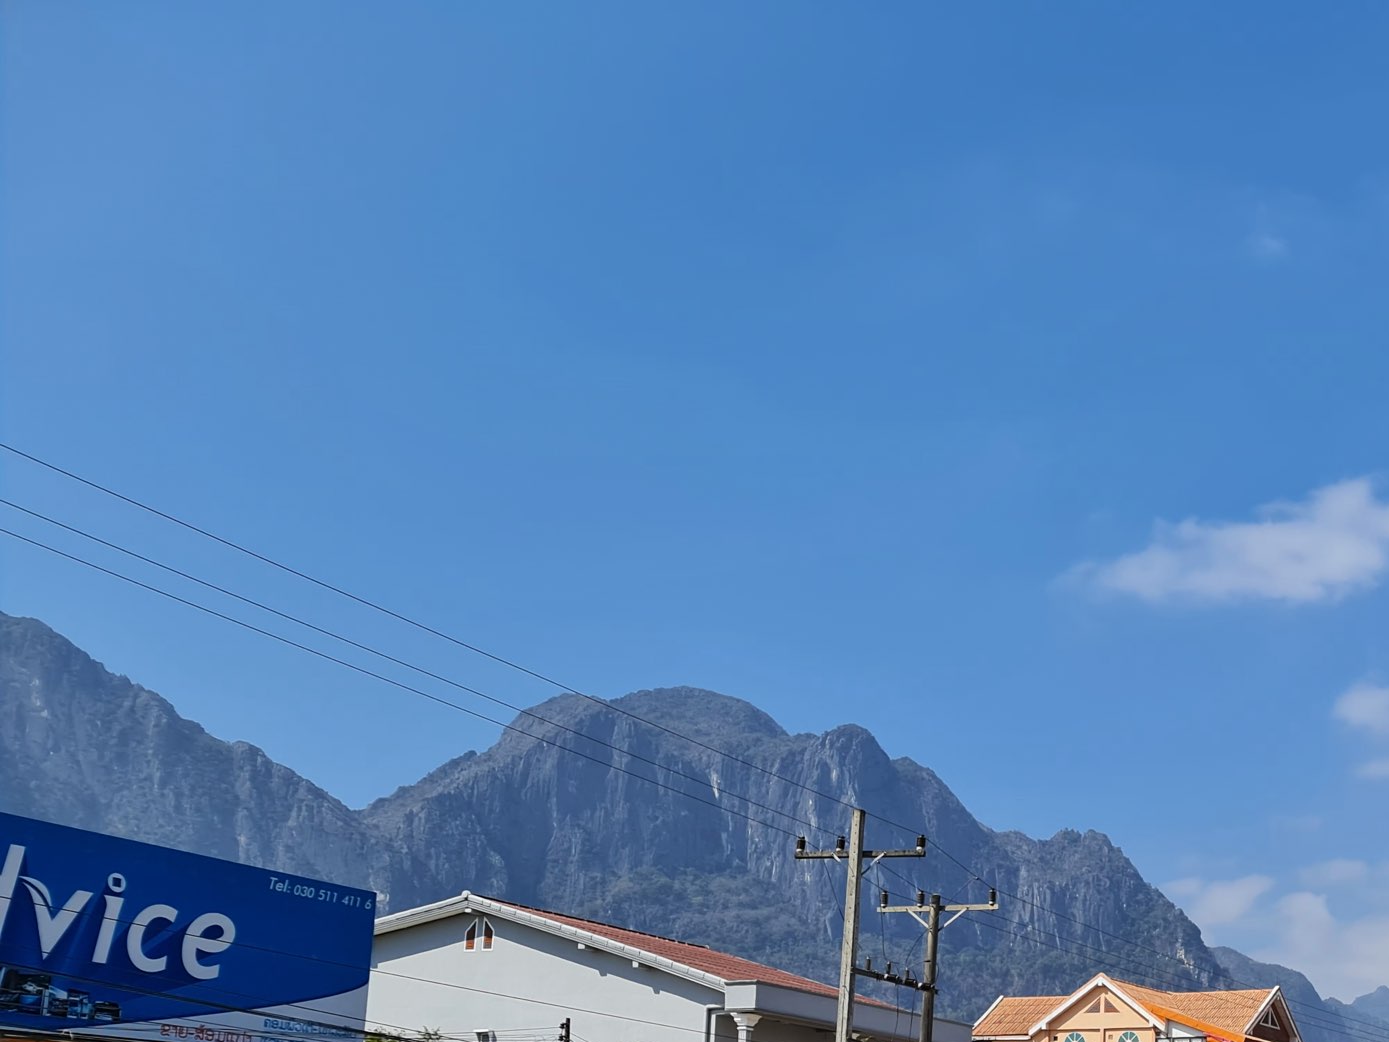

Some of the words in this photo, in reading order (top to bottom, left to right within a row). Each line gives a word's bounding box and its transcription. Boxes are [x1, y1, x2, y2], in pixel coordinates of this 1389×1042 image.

[269, 877, 291, 893] Tel:
[293, 884, 315, 898] 030
[318, 889, 338, 903] 511
[341, 895, 361, 908] 411
[364, 898, 372, 910] 6
